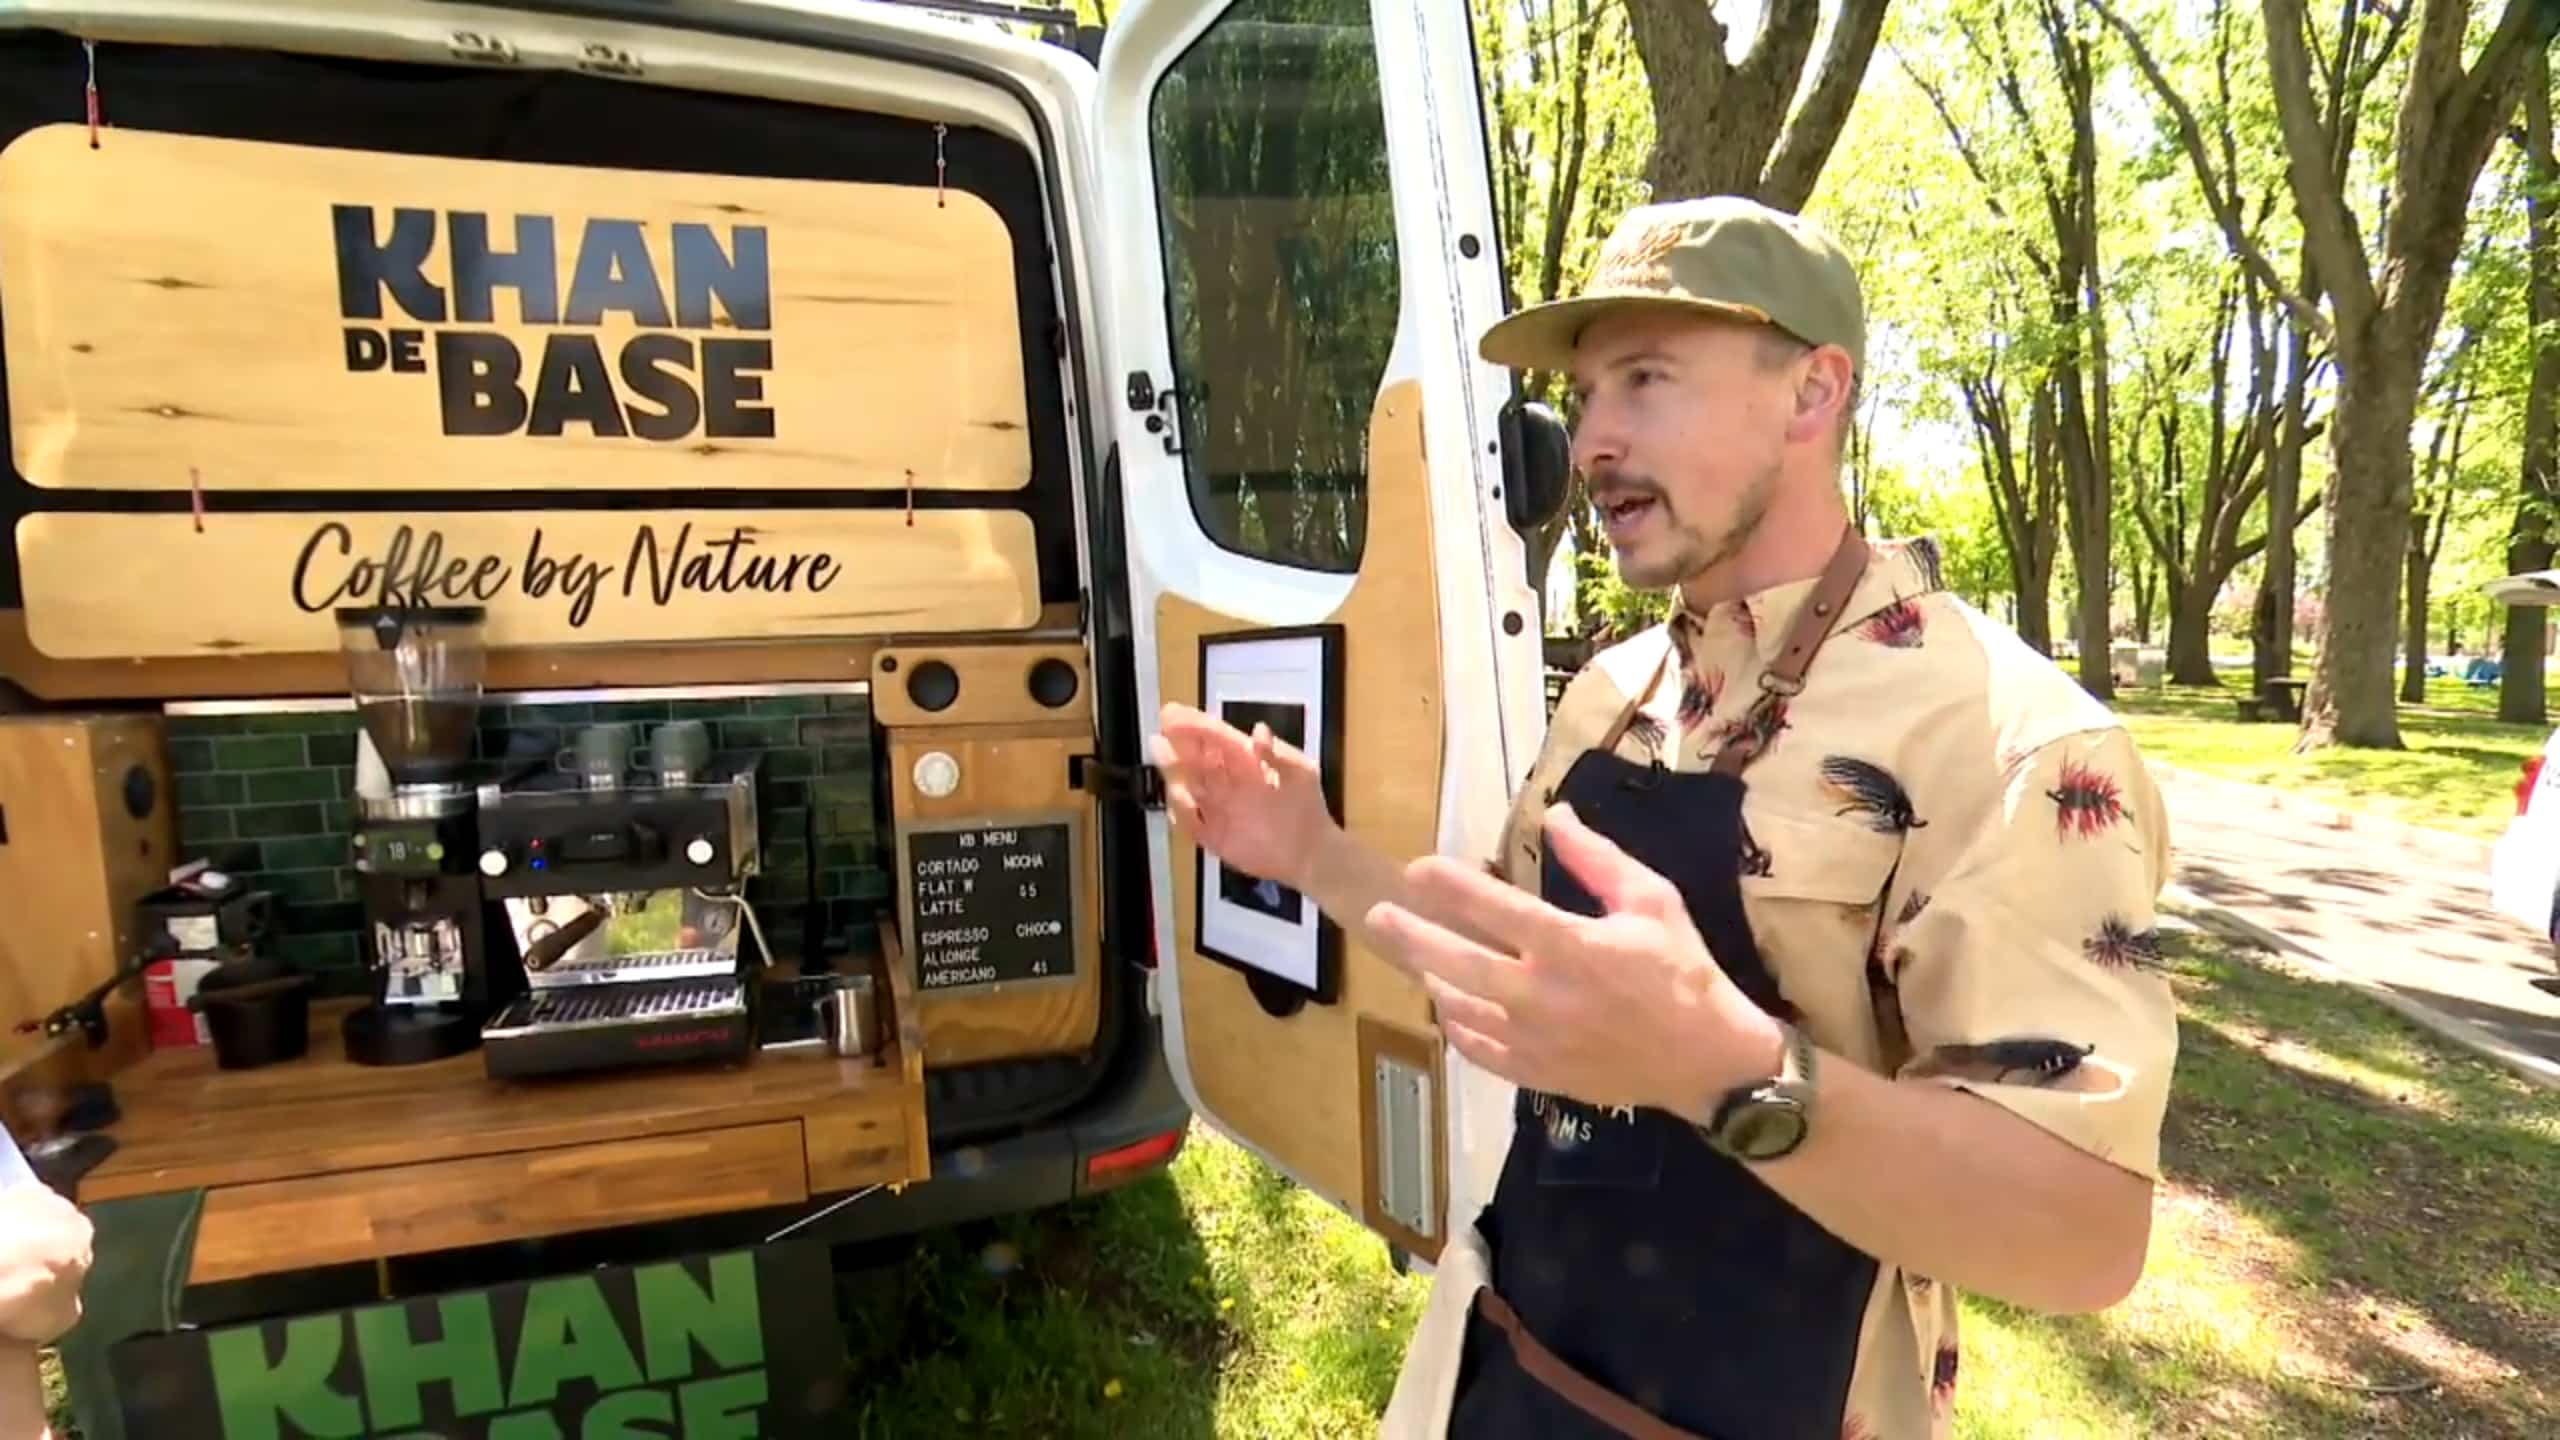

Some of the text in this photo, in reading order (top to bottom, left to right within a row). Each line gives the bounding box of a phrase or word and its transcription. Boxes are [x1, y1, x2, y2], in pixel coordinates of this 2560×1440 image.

[332, 204, 772, 331] KHAN
[343, 326, 777, 441] DE BASE
[292, 521, 843, 628] Coffee by Nature
[982, 830, 1018, 847] MENU
[917, 852, 1045, 876] CORTADO MOCHA
[918, 879, 954, 897] FLAT
[919, 899, 966, 917] LATTE
[921, 927, 990, 946] ESPRESSO
[922, 947, 982, 967] ALLONGE
[924, 965, 997, 987] AMERICANO
[206, 1250, 764, 1440] KHAN
